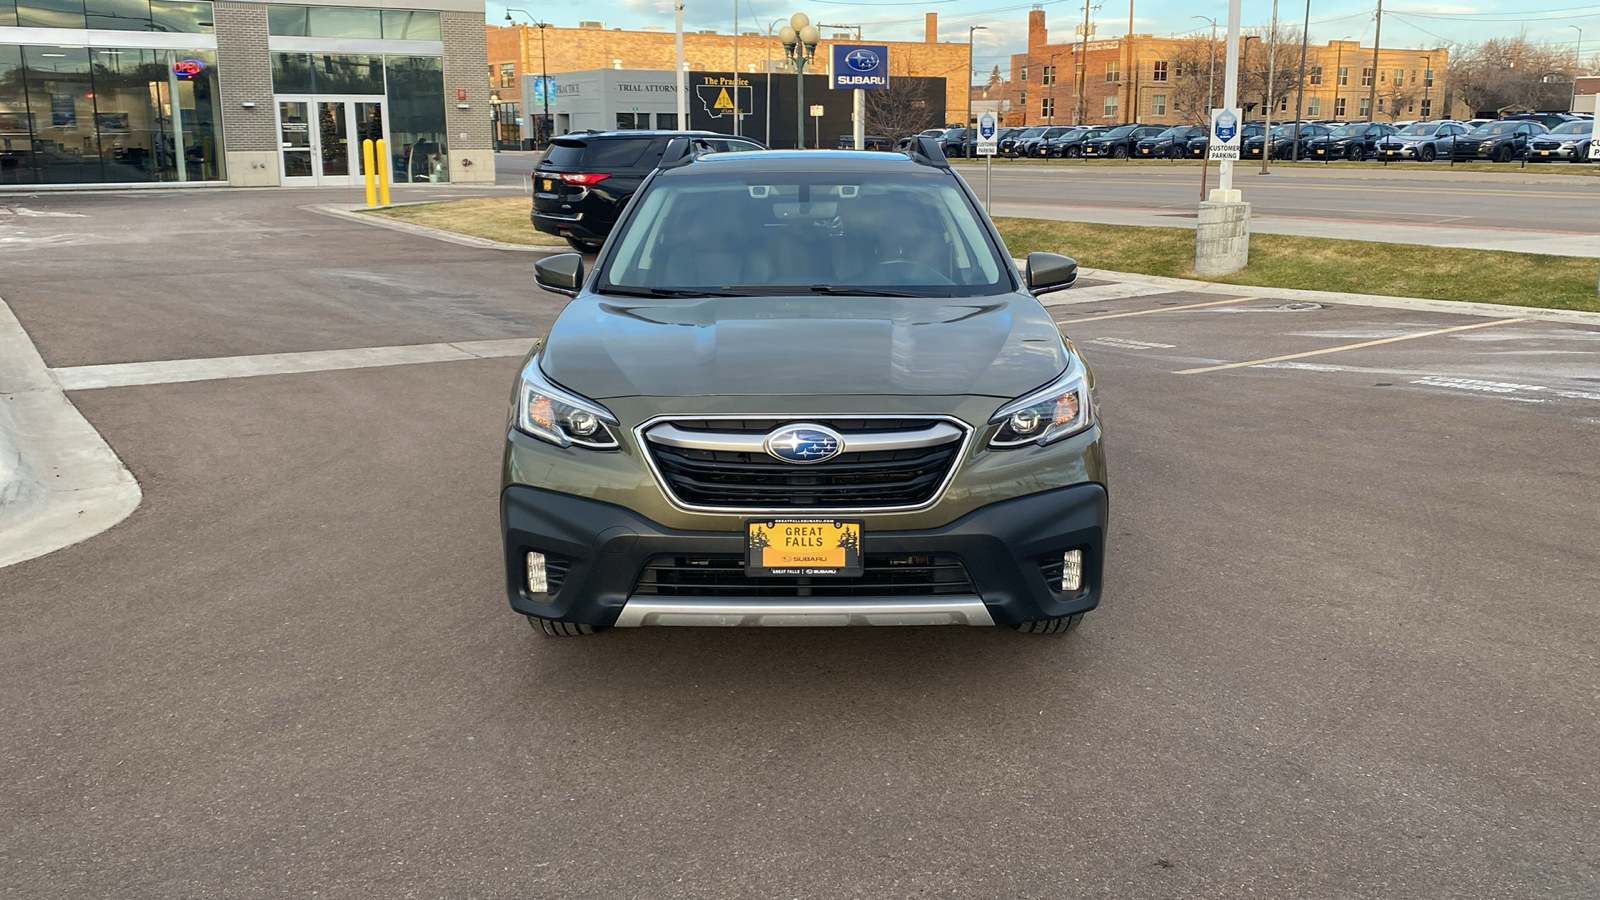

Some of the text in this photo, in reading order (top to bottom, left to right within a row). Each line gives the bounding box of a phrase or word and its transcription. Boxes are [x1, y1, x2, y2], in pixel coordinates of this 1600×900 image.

[173, 62, 200, 73] OPEN
[703, 76, 749, 86] The Pracice
[837, 75, 885, 85] SUBARU
[618, 84, 643, 92] TRIAL
[786, 527, 823, 536] GREAT
[786, 537, 823, 546] FALLS
